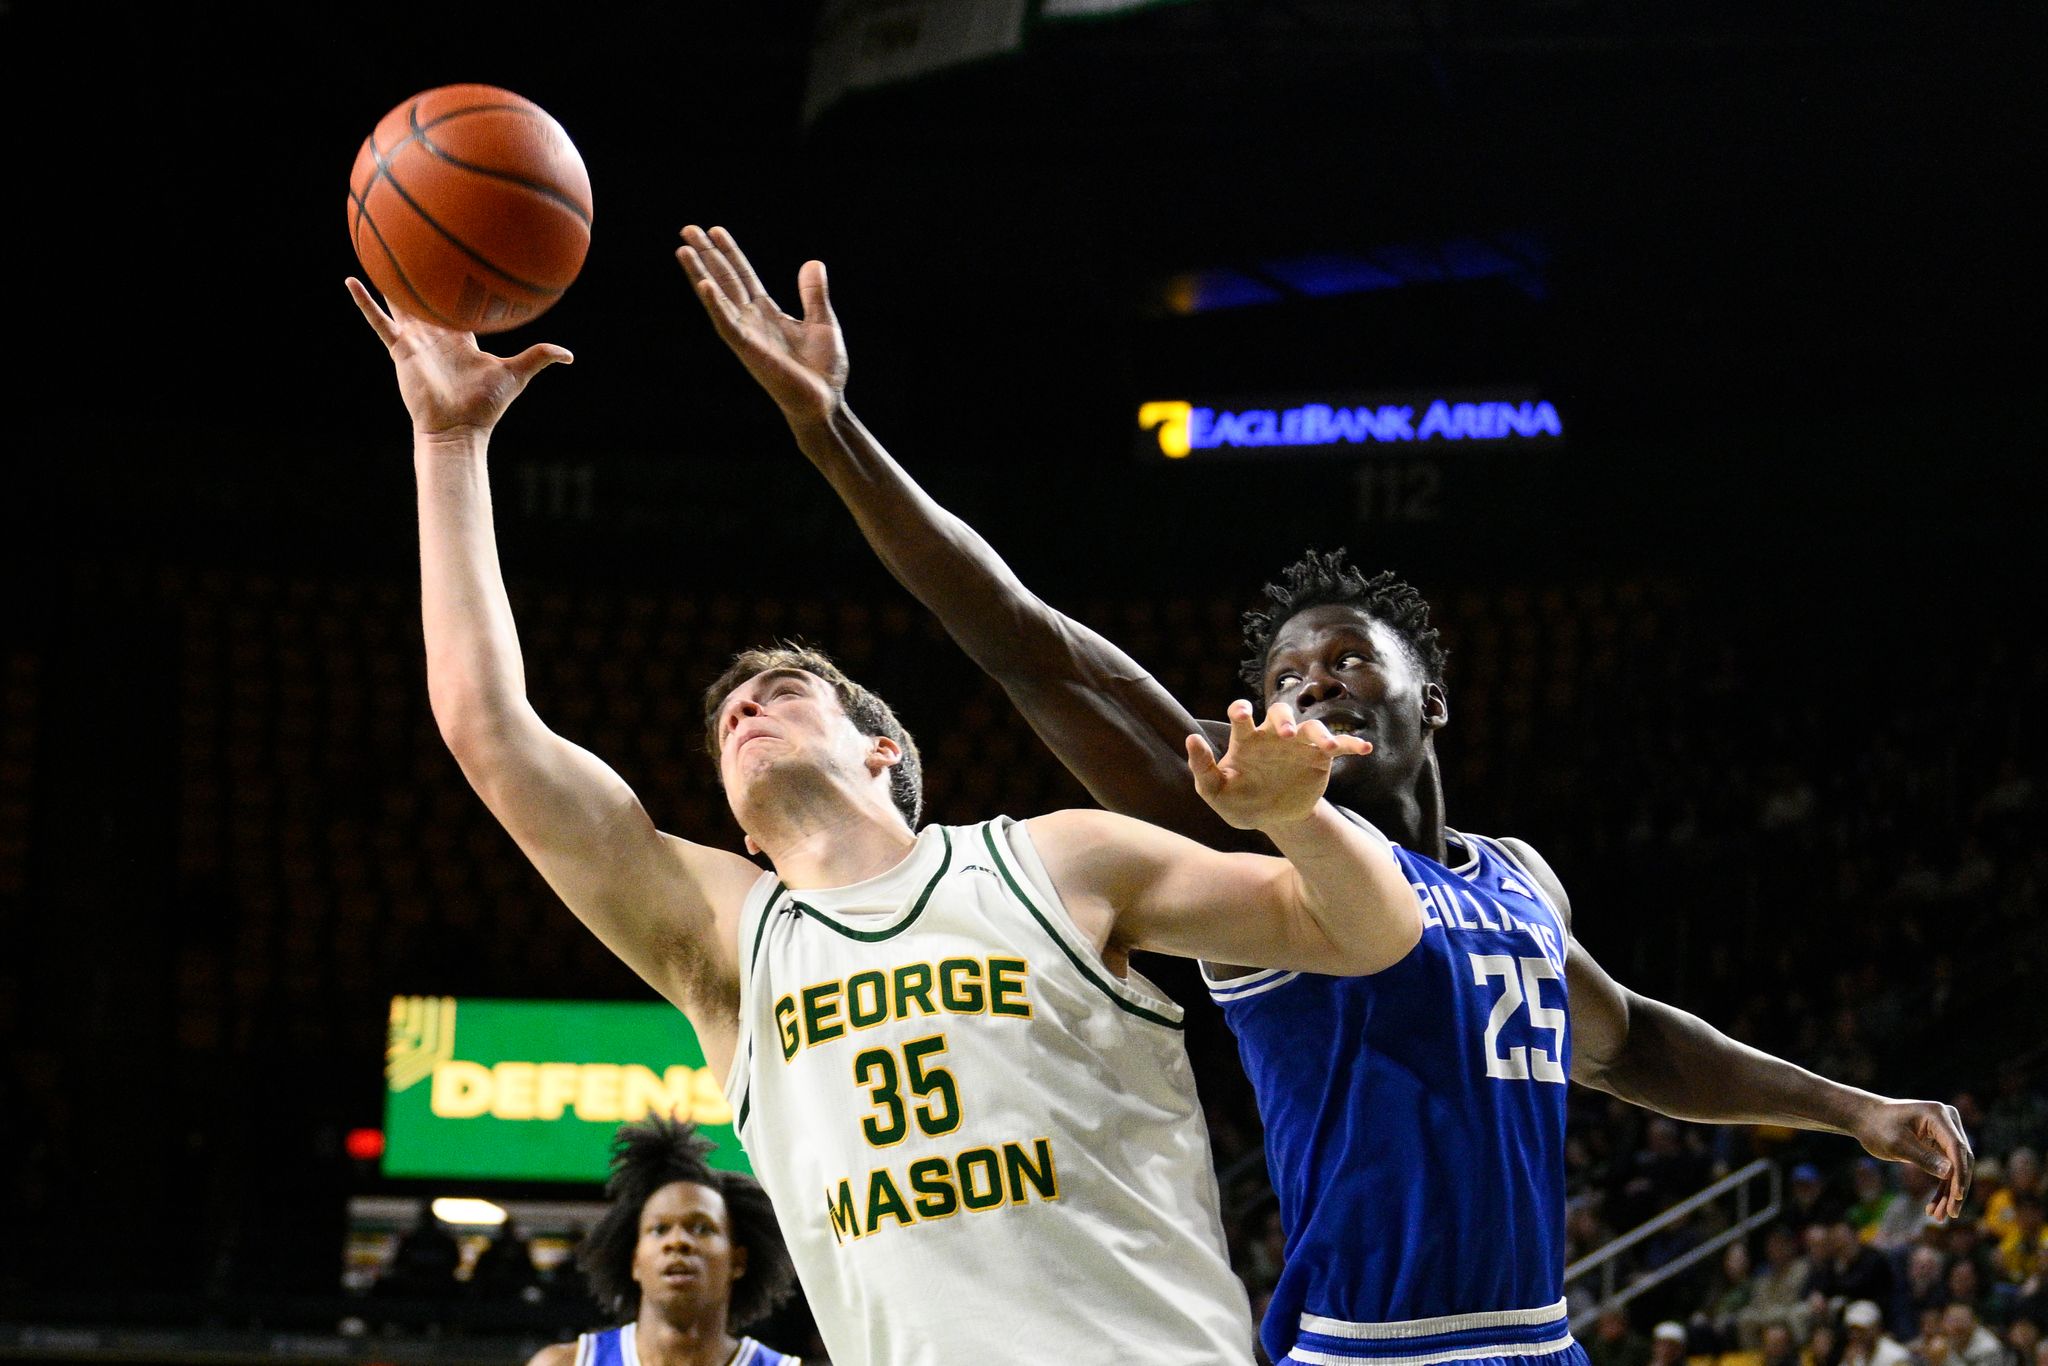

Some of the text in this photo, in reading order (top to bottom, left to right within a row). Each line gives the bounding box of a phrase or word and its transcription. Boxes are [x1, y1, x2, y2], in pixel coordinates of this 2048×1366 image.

[1412, 882, 1566, 977] BILLINS
[774, 956, 1033, 1064] GEORGE
[1467, 952, 1566, 1084] 25
[432, 1060, 734, 1124] DEFENS
[853, 1033, 962, 1149] 35
[824, 1137, 1059, 1247] MASON
